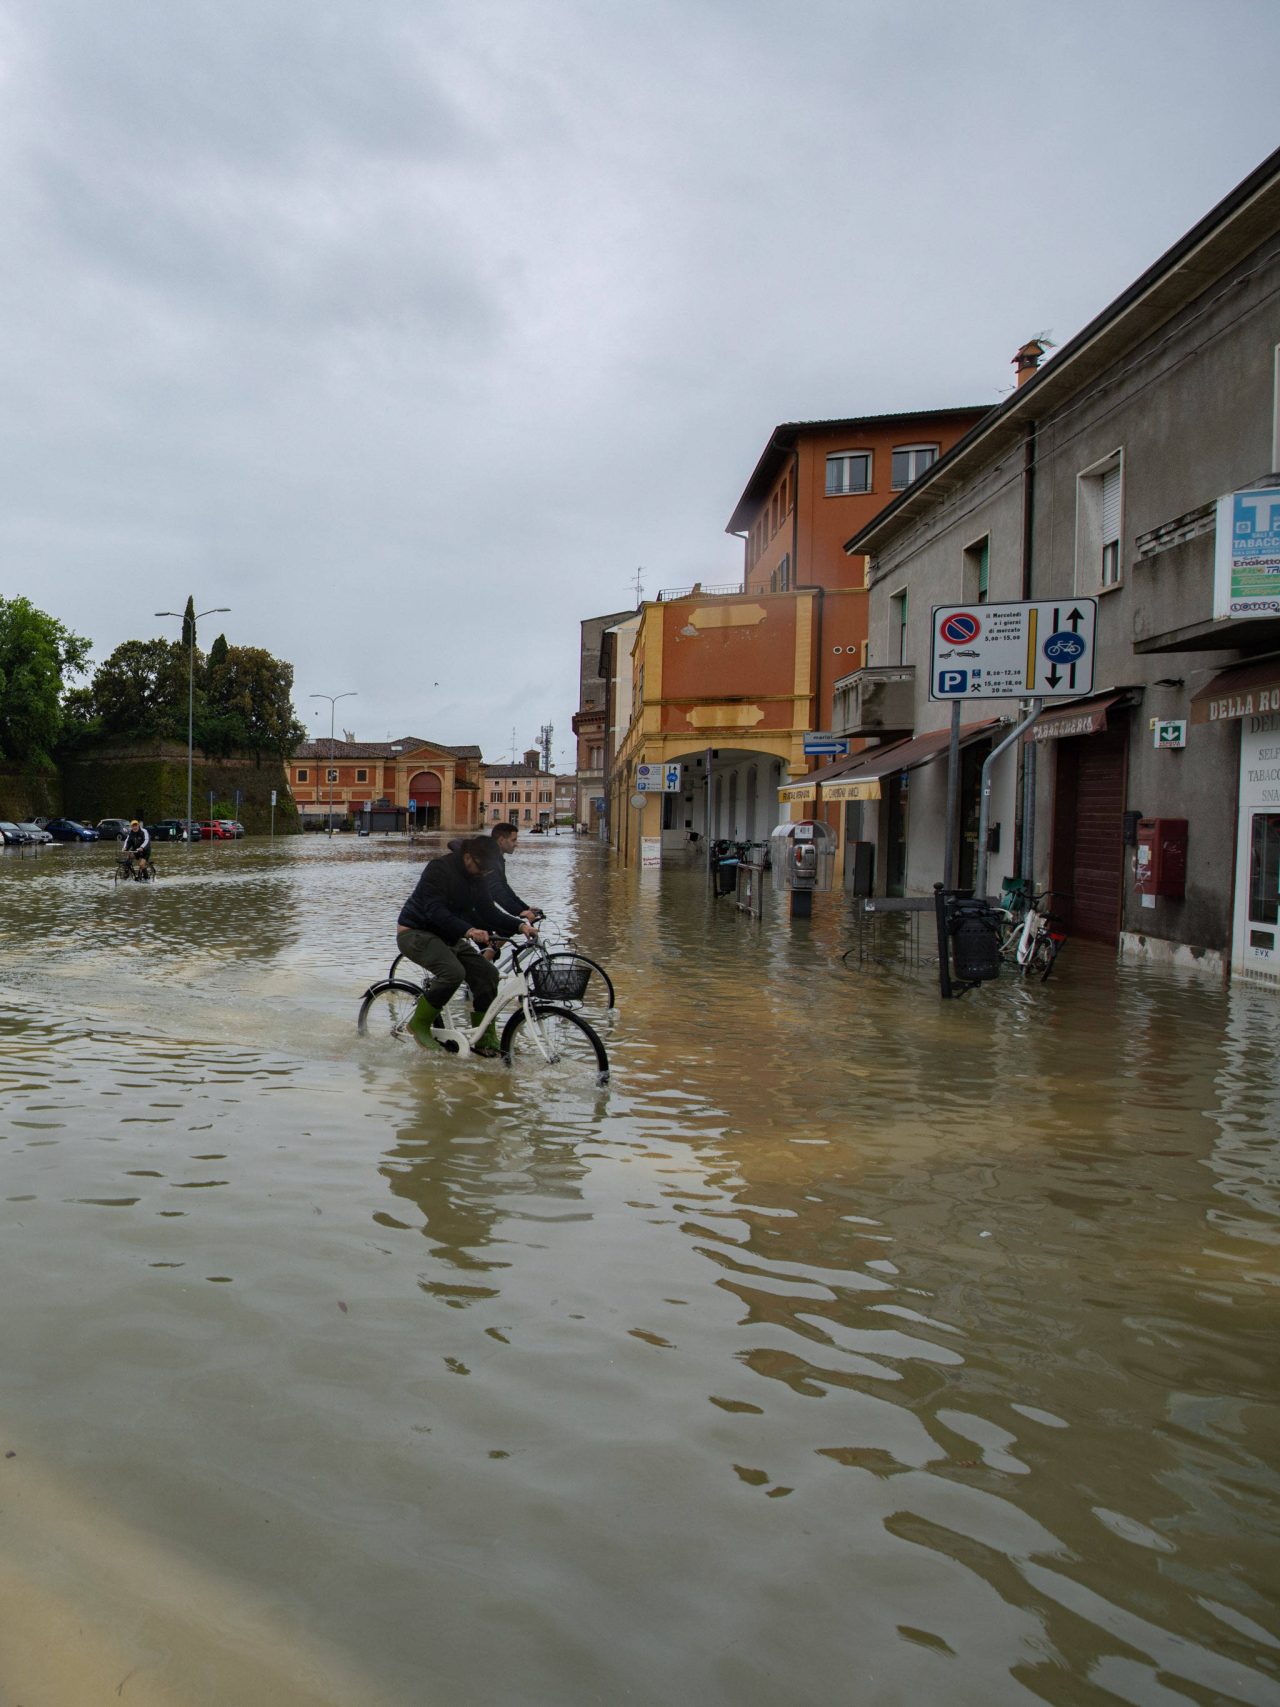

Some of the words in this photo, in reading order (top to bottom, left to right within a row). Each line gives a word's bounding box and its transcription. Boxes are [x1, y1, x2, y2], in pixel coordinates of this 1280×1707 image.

[1233, 559, 1280, 568] Enalotto
[1231, 601, 1279, 612] LOTTO
[944, 672, 962, 691] P
[1209, 694, 1254, 721] DELLA
[1261, 788, 1280, 801] SNA
